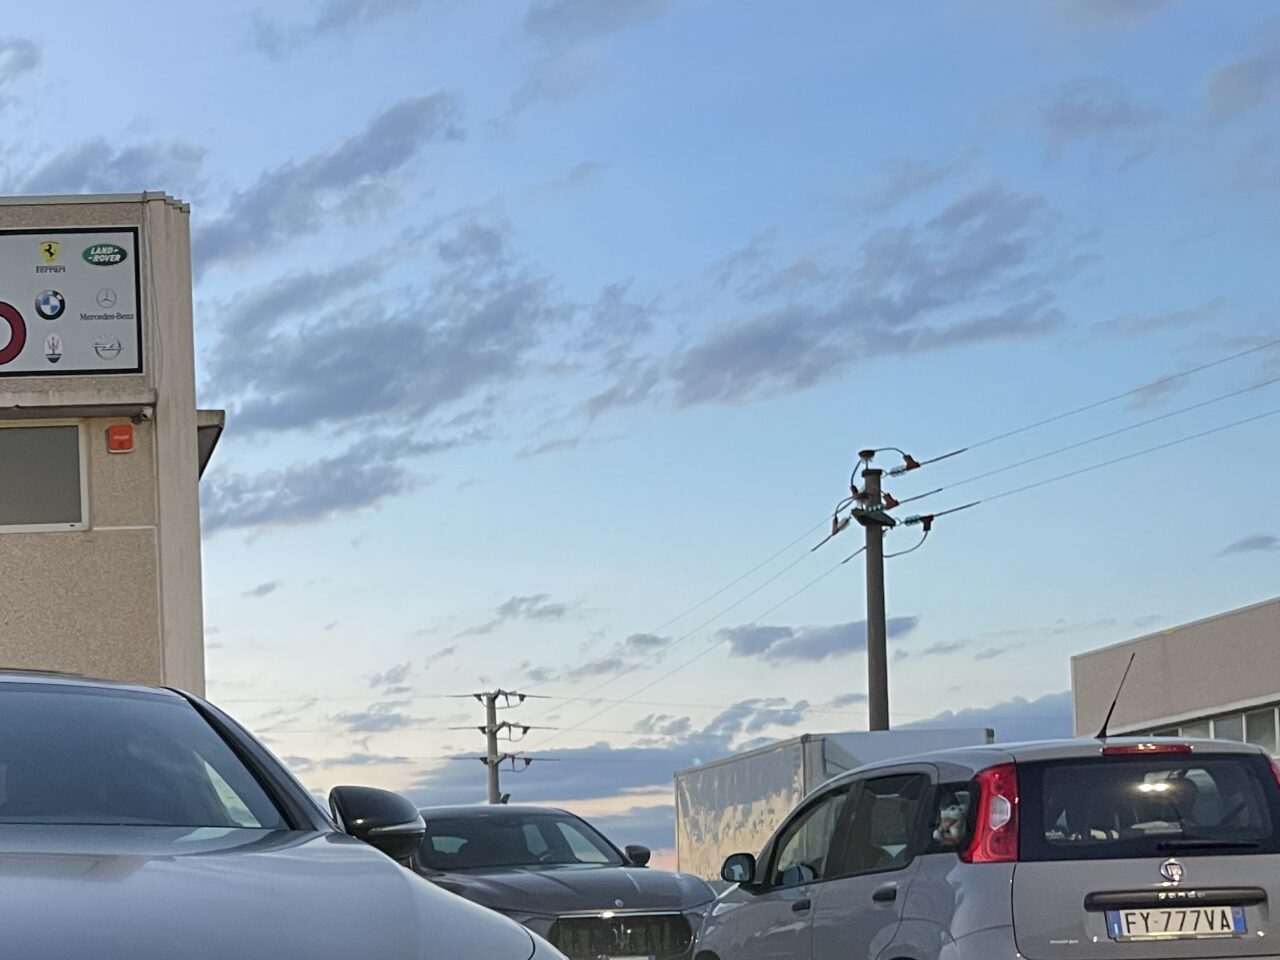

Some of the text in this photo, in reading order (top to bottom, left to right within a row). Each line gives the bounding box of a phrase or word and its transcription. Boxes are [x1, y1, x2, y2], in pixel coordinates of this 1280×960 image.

[90, 247, 114, 255] LAND
[92, 254, 121, 262] ROVER
[1125, 909, 1232, 934] FY 777VA
